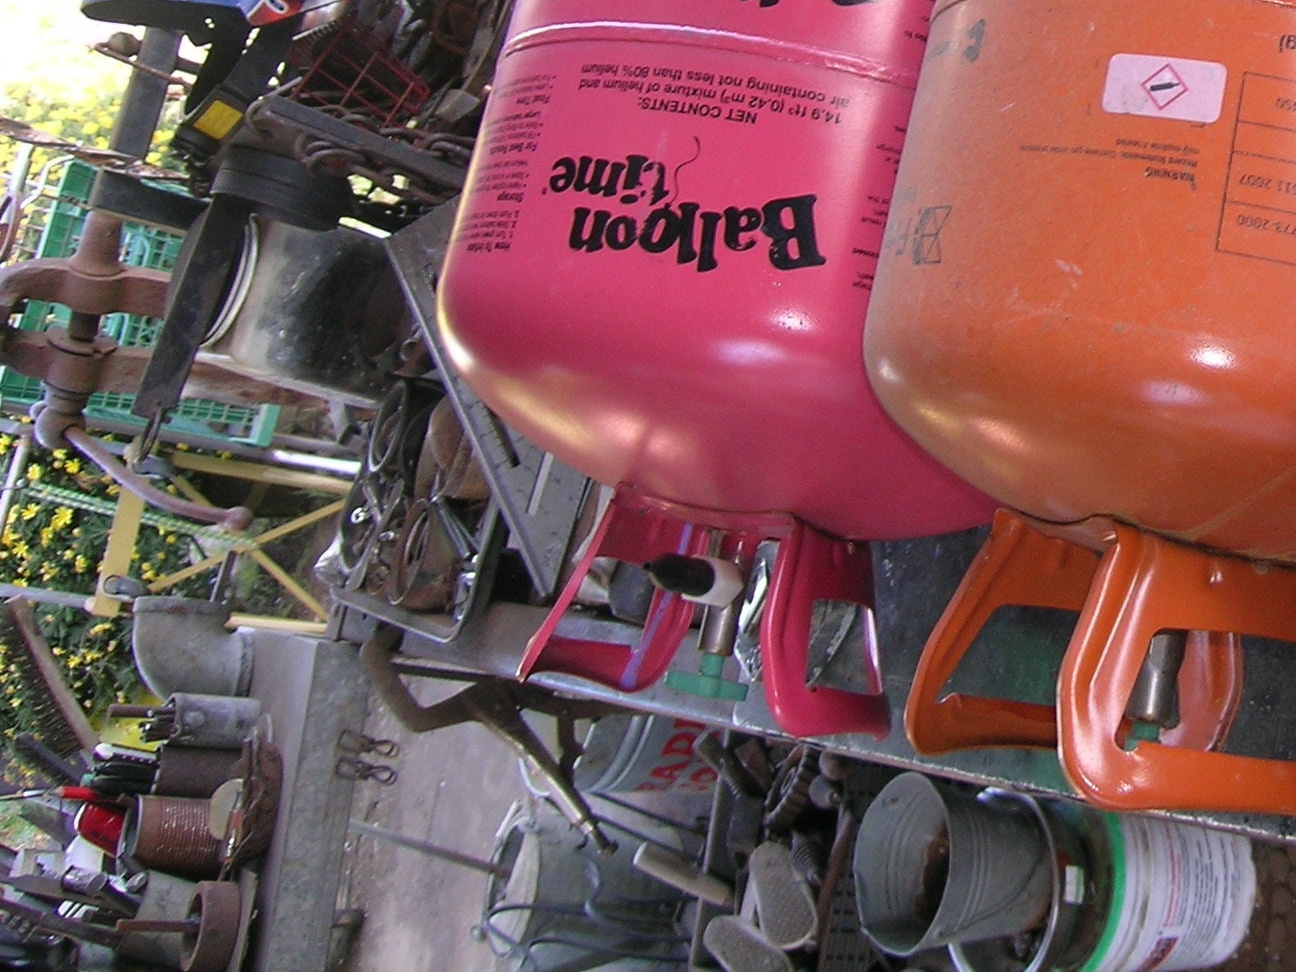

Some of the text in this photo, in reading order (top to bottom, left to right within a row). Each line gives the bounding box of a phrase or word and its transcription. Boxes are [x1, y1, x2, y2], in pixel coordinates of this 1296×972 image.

[578, 77, 601, 91] and
[580, 63, 850, 109] air containing not less than 80% helium
[603, 79, 642, 92] helium
[645, 81, 660, 94] of
[662, 83, 717, 101] mixture
[636, 95, 757, 124] NET CONTENTS:
[747, 94, 785, 114] (0.42
[810, 107, 841, 124] 14.9
[548, 154, 670, 207] time
[1238, 173, 1272, 189] 2007
[569, 193, 827, 273] Balloon
